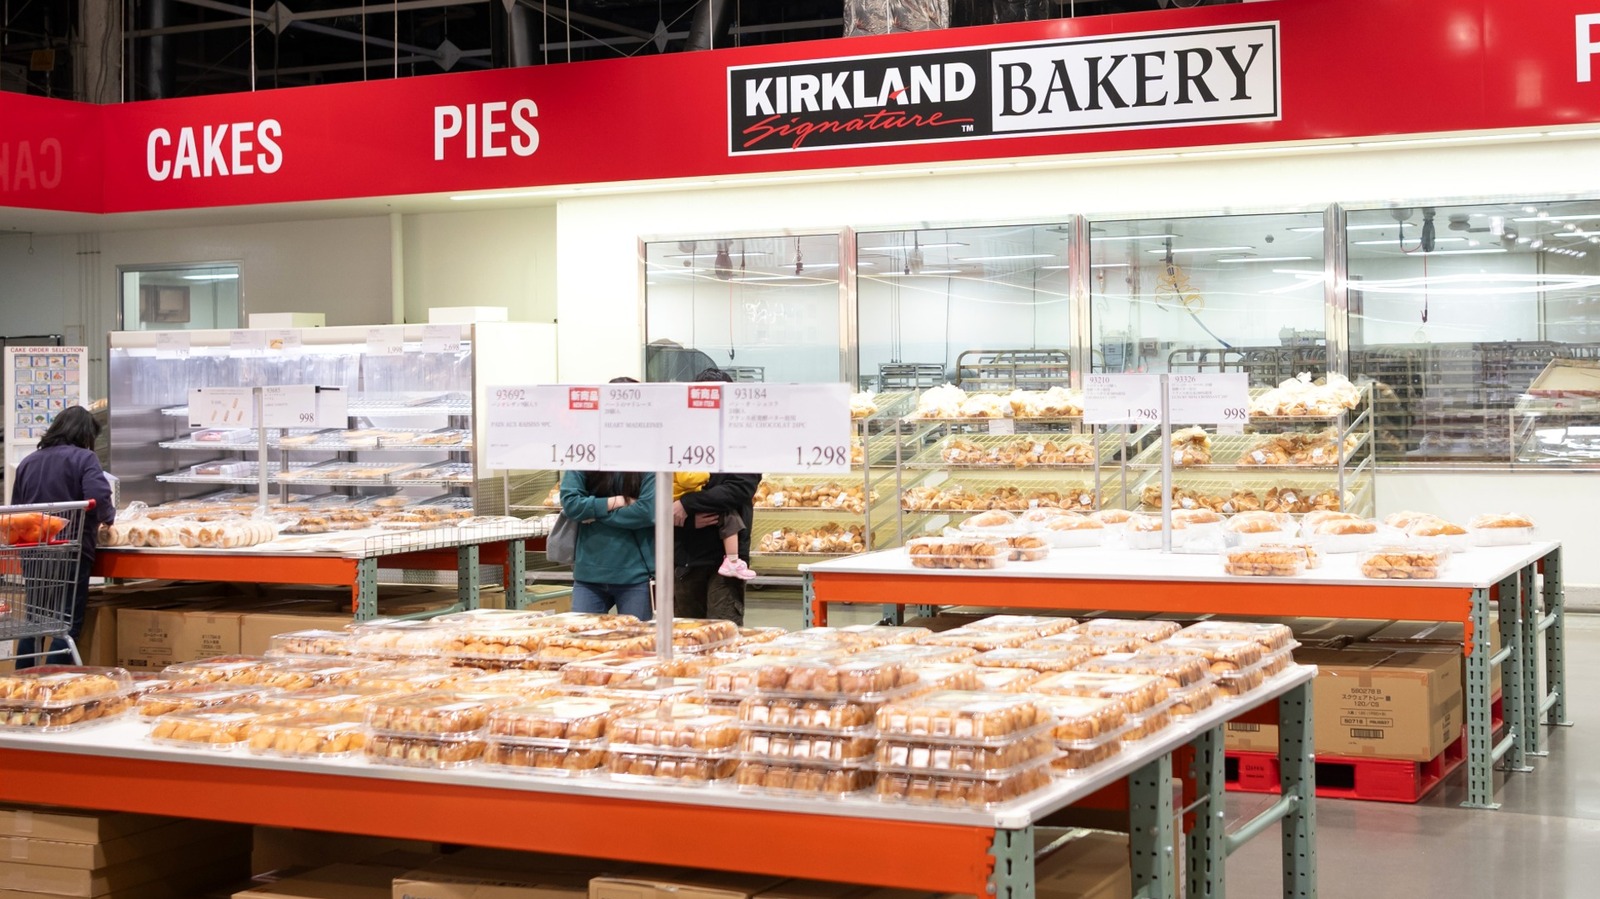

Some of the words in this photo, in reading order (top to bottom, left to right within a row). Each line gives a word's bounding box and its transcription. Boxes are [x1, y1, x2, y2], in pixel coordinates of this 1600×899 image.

[745, 62, 977, 117] KIRKLAND
[999, 43, 1264, 117] BAKERY
[434, 99, 540, 161] PIES
[743, 109, 975, 150] Signature
[146, 118, 283, 182] CAKES
[496, 389, 525, 400] 93692
[571, 390, 598, 401] 新商品
[609, 389, 641, 400] 93670
[690, 388, 720, 400] 新商品
[734, 388, 767, 399] 93184
[299, 412, 315, 423] 998
[1223, 407, 1246, 420] 998
[551, 443, 596, 466] 1,498
[668, 445, 716, 468] 1,498
[796, 445, 847, 469] 1,298
